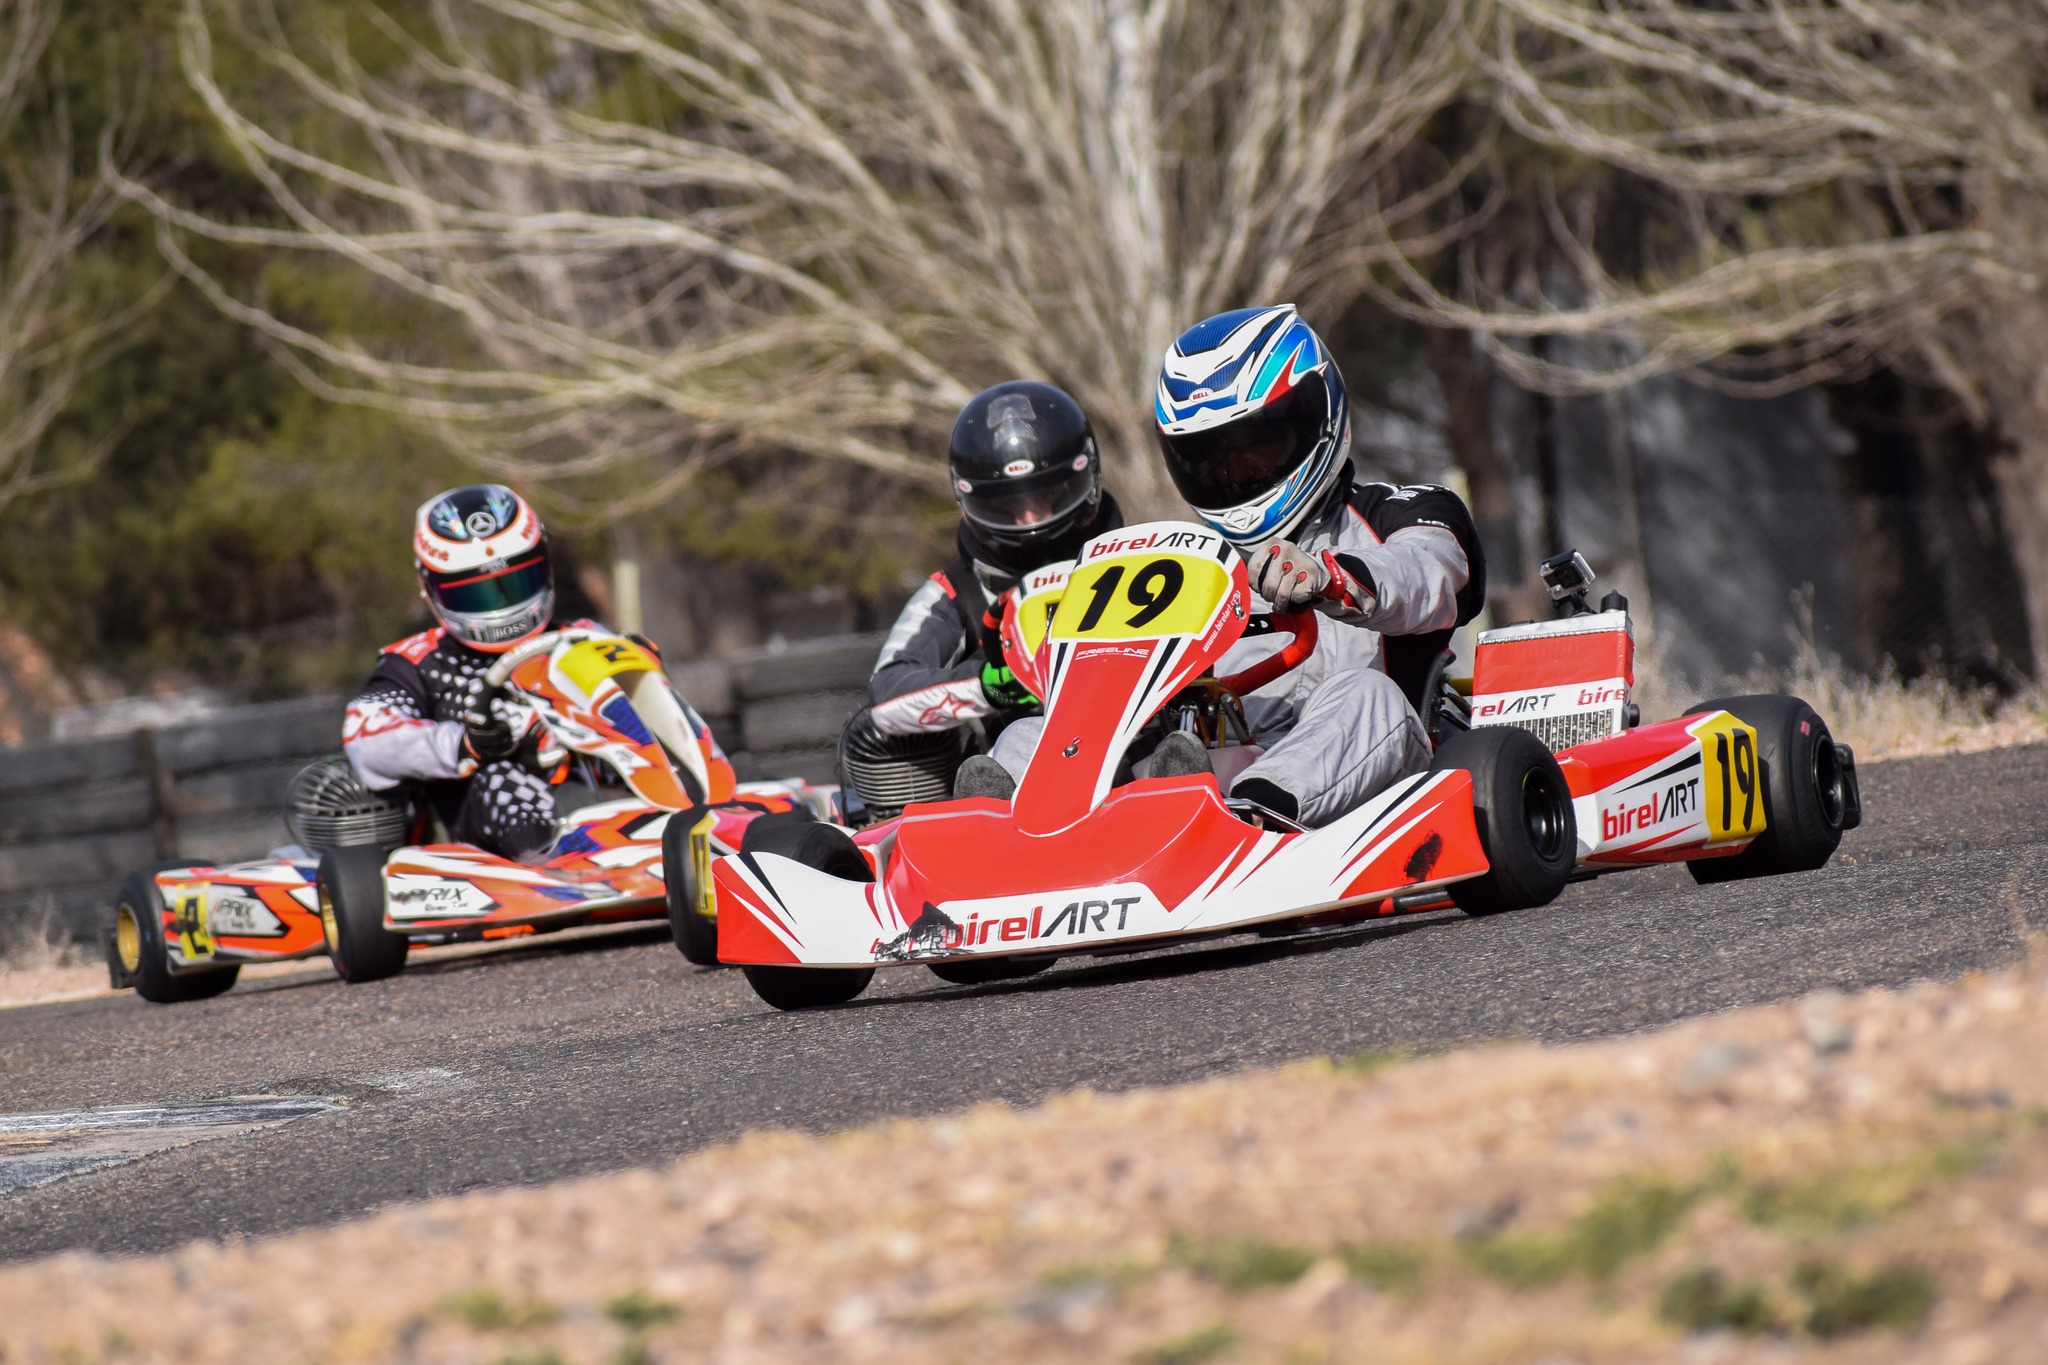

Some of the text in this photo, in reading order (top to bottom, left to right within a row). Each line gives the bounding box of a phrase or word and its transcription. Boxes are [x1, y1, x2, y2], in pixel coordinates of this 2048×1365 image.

[1193, 391, 1209, 400] BELL
[1089, 532, 1216, 559] birelART
[1033, 572, 1073, 589] bir
[1077, 559, 1184, 632] 19
[1076, 647, 1150, 658] FREELINE
[1715, 728, 1755, 832] 19
[1602, 777, 1699, 841] birelART
